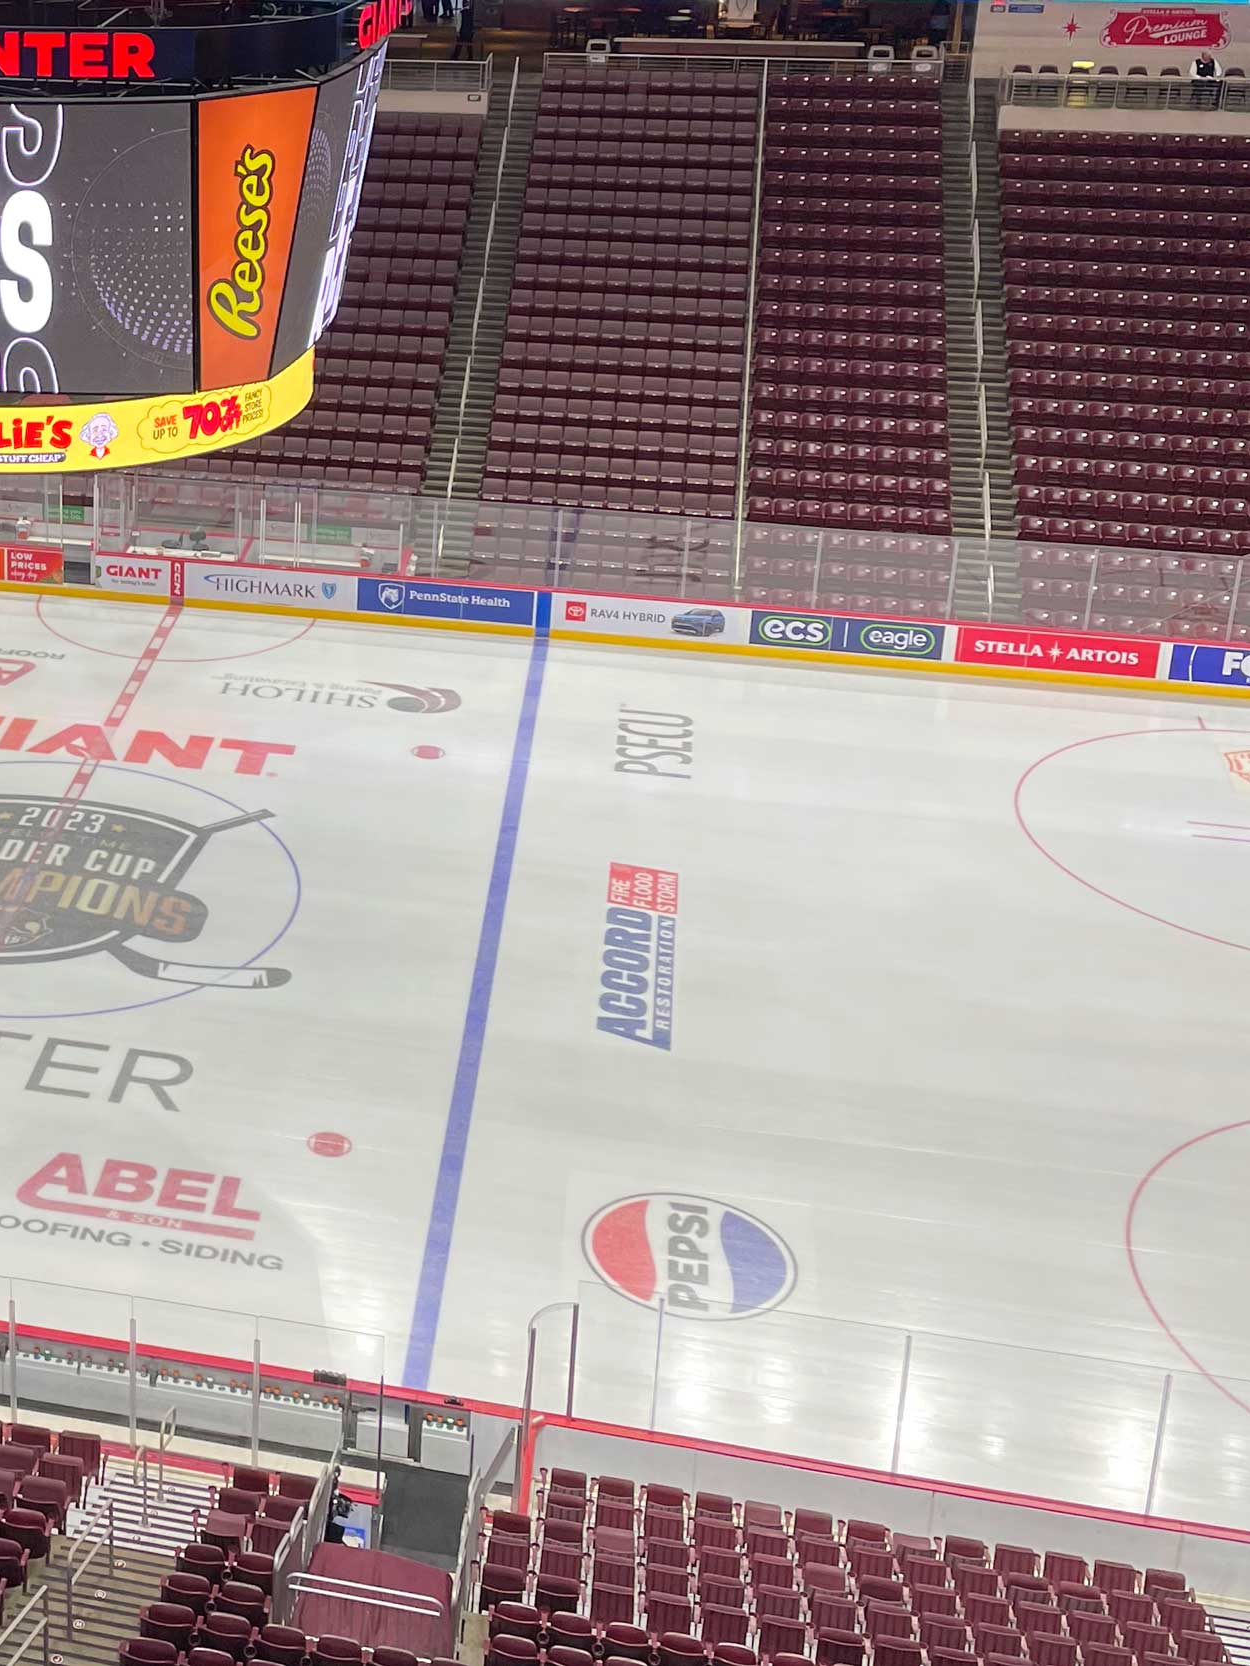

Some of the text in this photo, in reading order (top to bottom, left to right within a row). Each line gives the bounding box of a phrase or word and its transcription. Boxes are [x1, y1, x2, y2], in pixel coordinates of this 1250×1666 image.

[1123, 15, 1208, 43] Premium
[1163, 29, 1208, 44] LOUNGE
[207, 144, 275, 340] Reese's
[244, 400, 263, 413] STORE
[245, 389, 263, 402] FANCY
[153, 427, 178, 440] UP TO
[154, 414, 178, 428] SAVE
[10, 552, 33, 560] LOW
[10, 561, 48, 571] PRICES
[106, 564, 162, 580] GIANT
[215, 576, 317, 599] HIGHMARK
[471, 594, 511, 608] Health
[591, 608, 667, 624] RAV4 HYBRID
[763, 618, 825, 643] ecs
[868, 629, 927, 650] eagle
[974, 639, 1140, 665] STELLA ARTOIS
[220, 682, 379, 710] SHILOH
[613, 708, 694, 780] PSECU
[18, 806, 107, 834] 2023
[83, 849, 157, 880] CUP
[610, 878, 631, 904] FIRE
[633, 872, 654, 910] FLOOD
[656, 873, 676, 913] STORM
[596, 906, 653, 1046] ACCORD
[654, 918, 675, 1030] RESTORATION
[16, 1151, 262, 1224] ABEL
[132, 1212, 184, 1230] SON
[158, 1238, 285, 1271] SIDING
[667, 1201, 710, 1312] PEPSI
